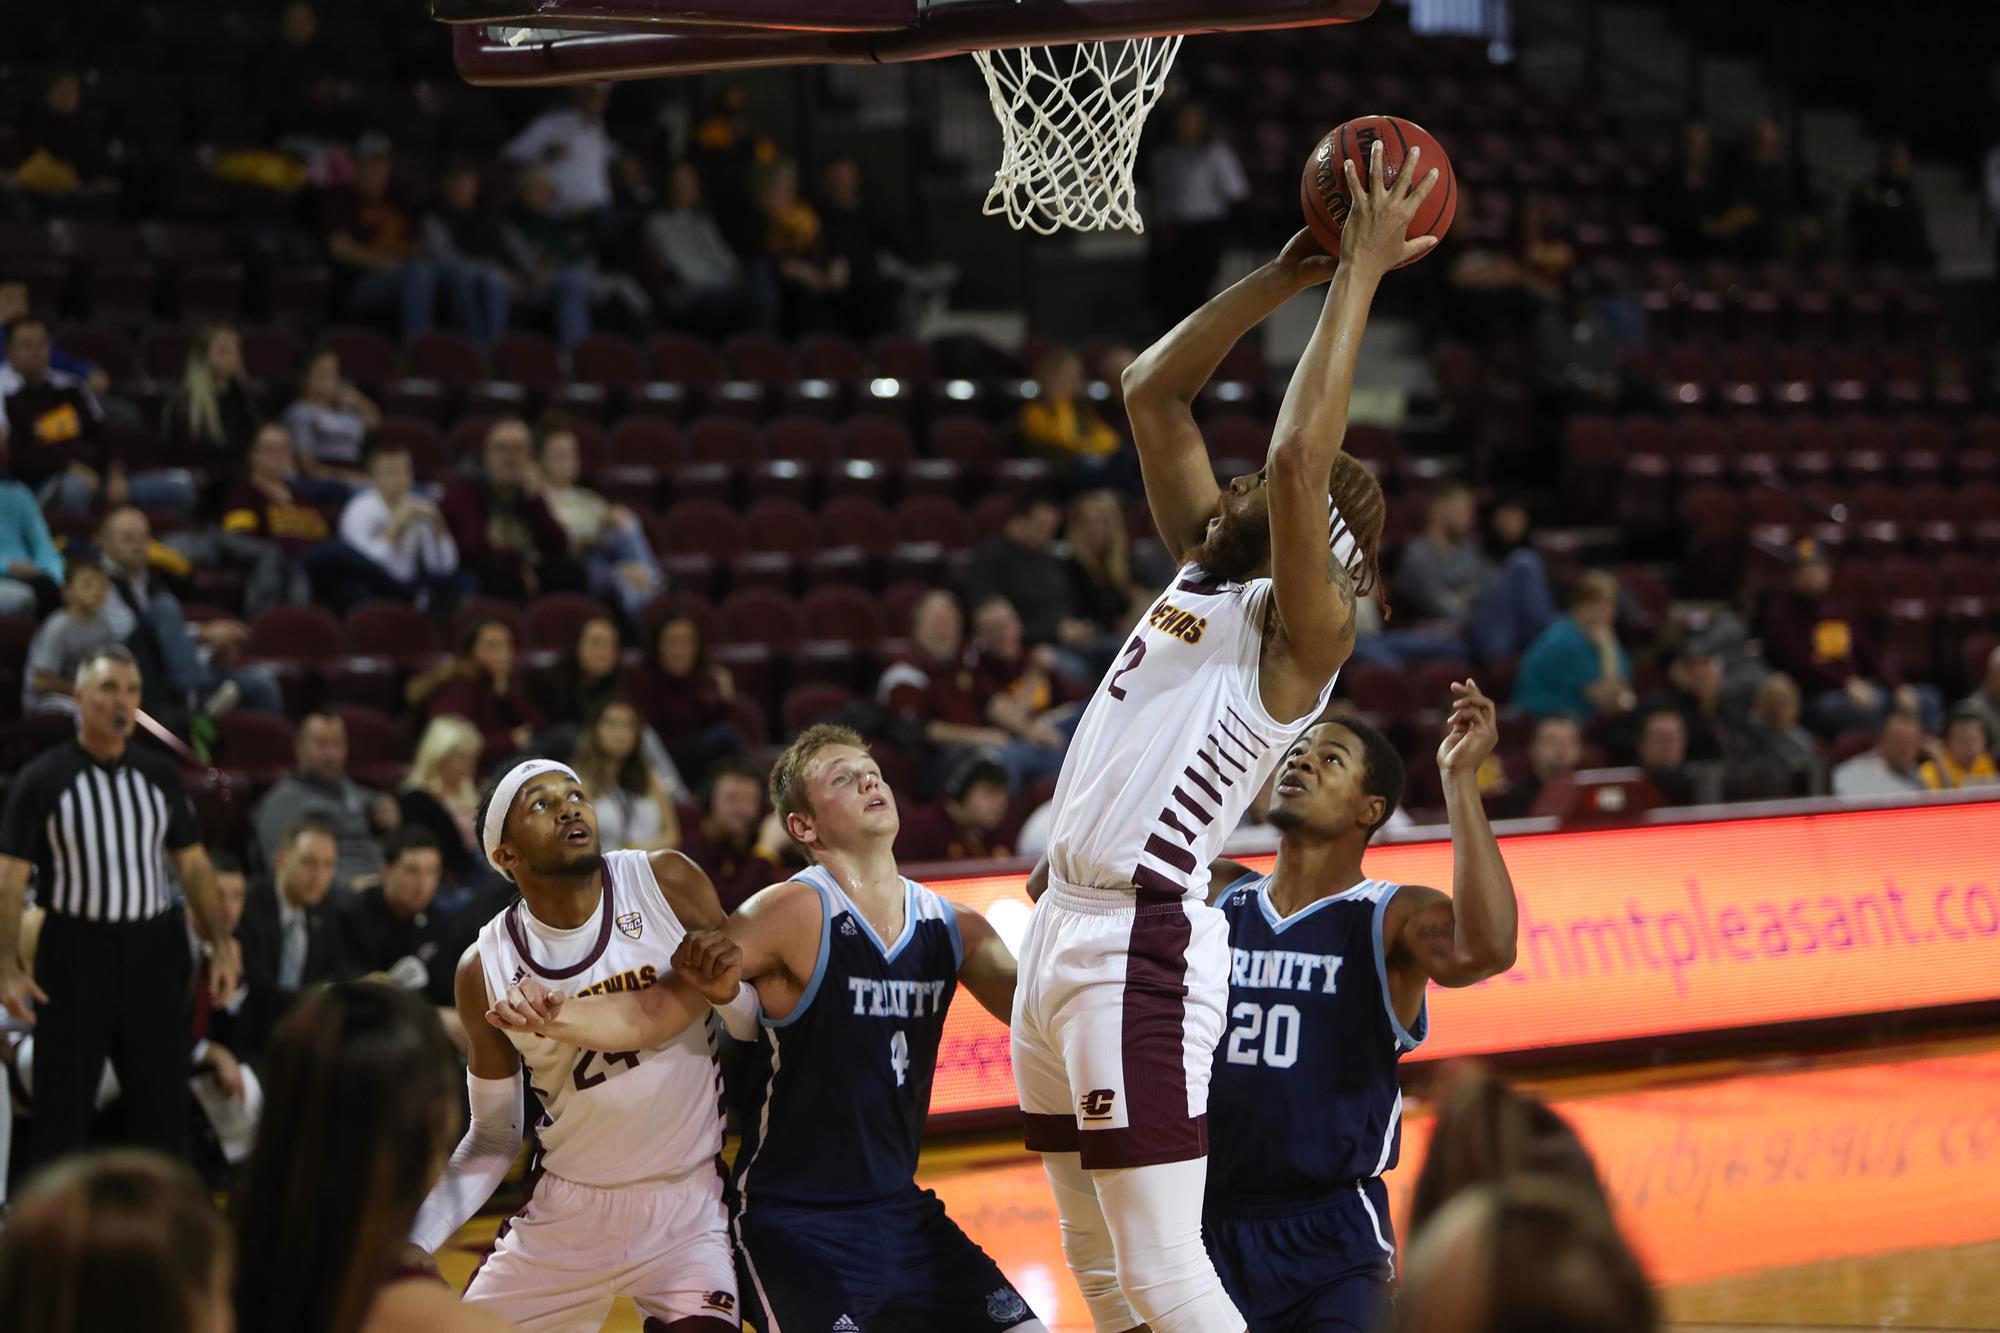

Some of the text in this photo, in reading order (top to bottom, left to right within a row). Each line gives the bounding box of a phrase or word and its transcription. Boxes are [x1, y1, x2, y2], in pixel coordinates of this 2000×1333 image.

[1108, 635, 1147, 701] 2
[1230, 947, 1344, 995] RINITY
[890, 1030, 910, 1087] 4
[1226, 1001, 1301, 1069] 20
